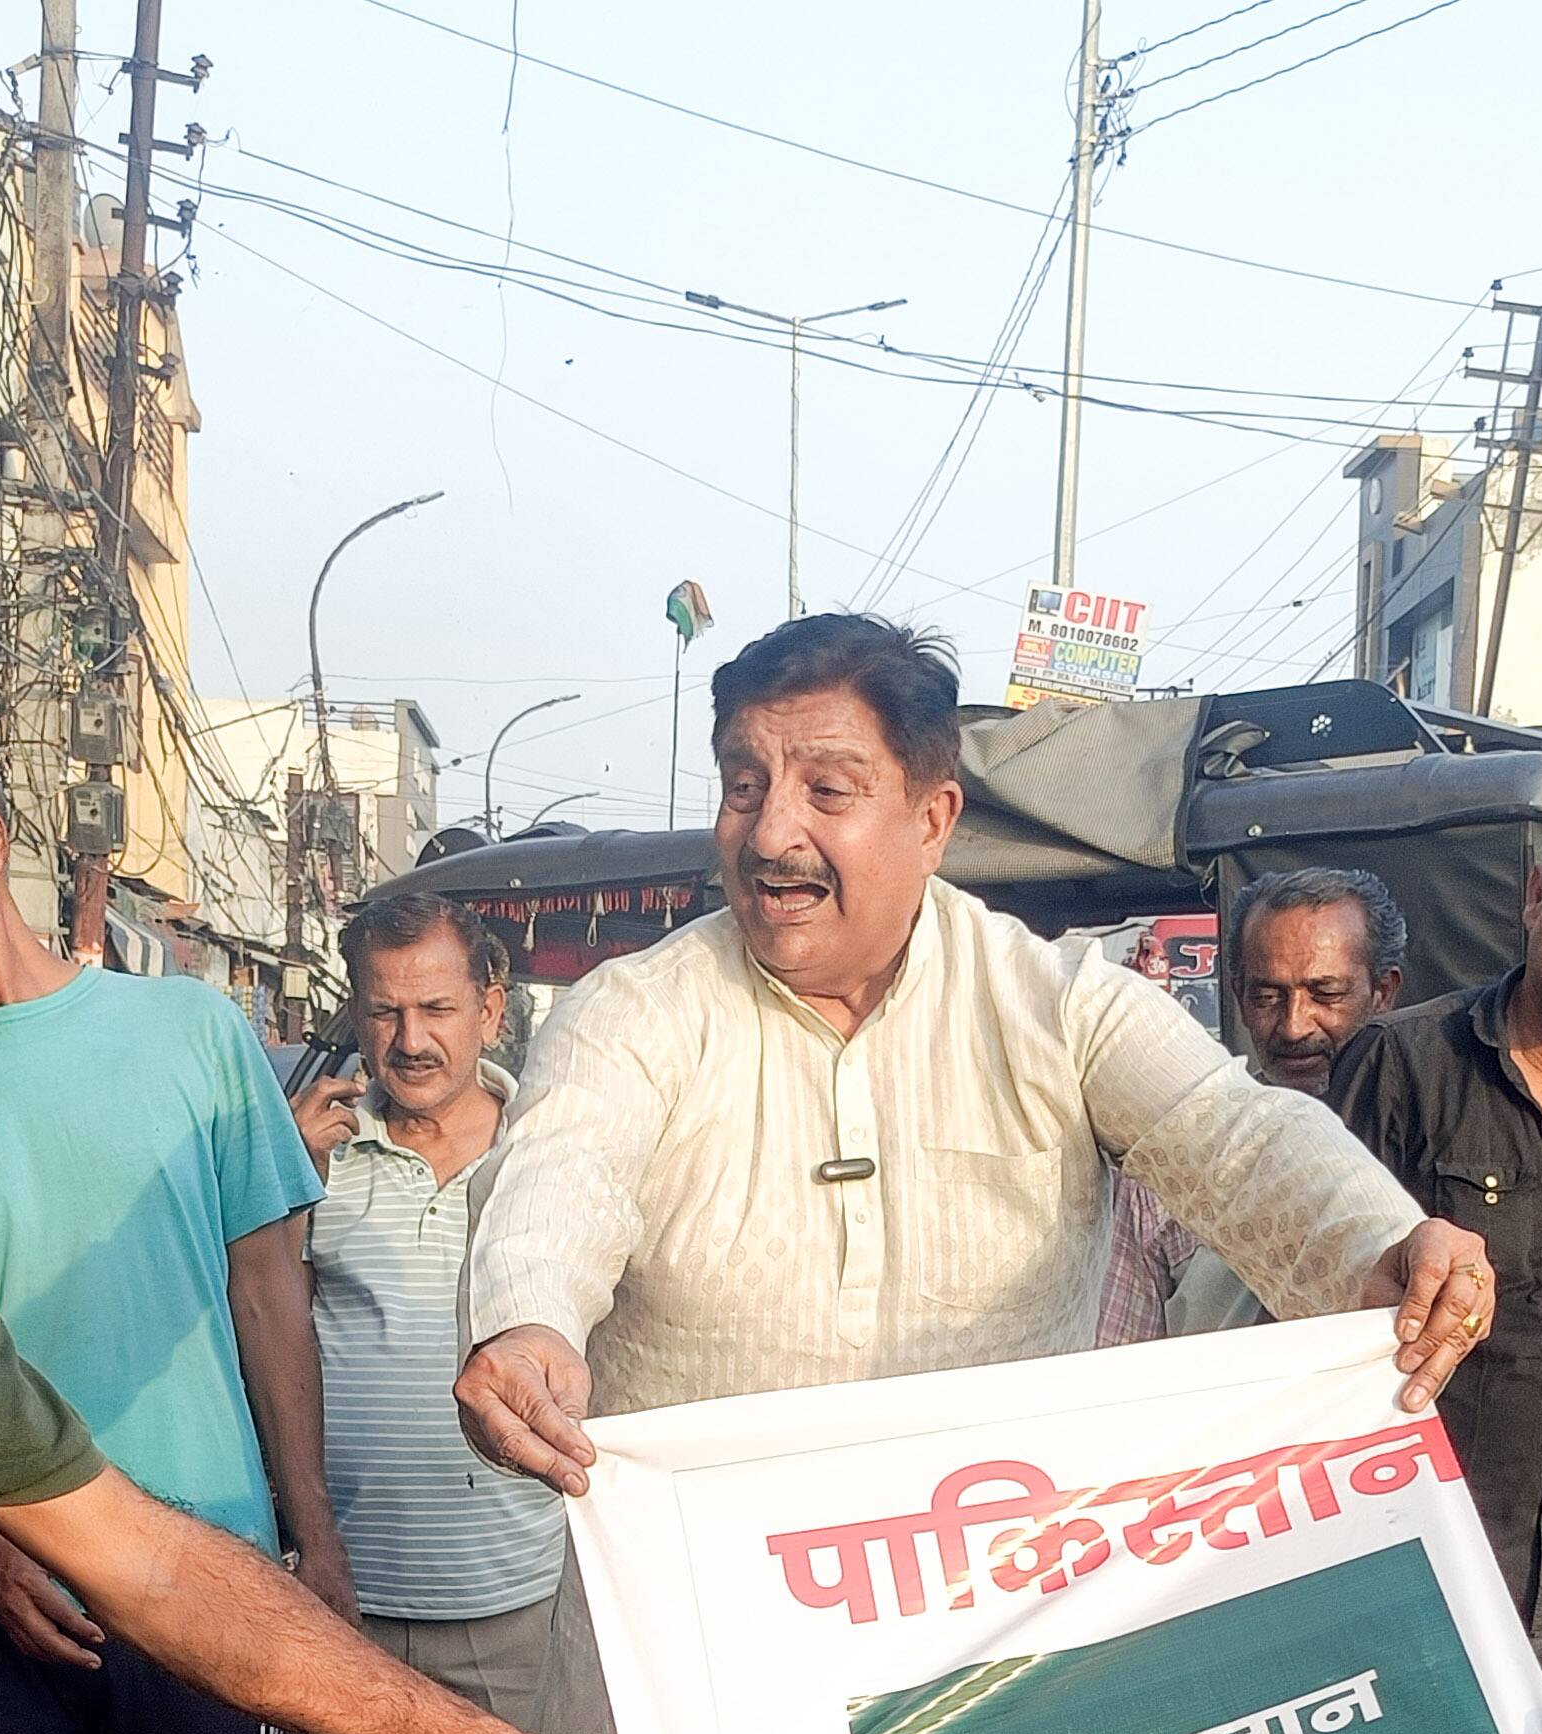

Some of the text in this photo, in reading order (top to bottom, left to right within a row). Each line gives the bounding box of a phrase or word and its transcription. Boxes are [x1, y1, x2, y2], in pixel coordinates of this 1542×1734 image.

[1064, 591, 1146, 634] CIIT
[1053, 663, 1134, 684] COURSES
[1054, 642, 1140, 675] COMPUTER
[766, 1415, 1466, 1625] पाकिस्तान
